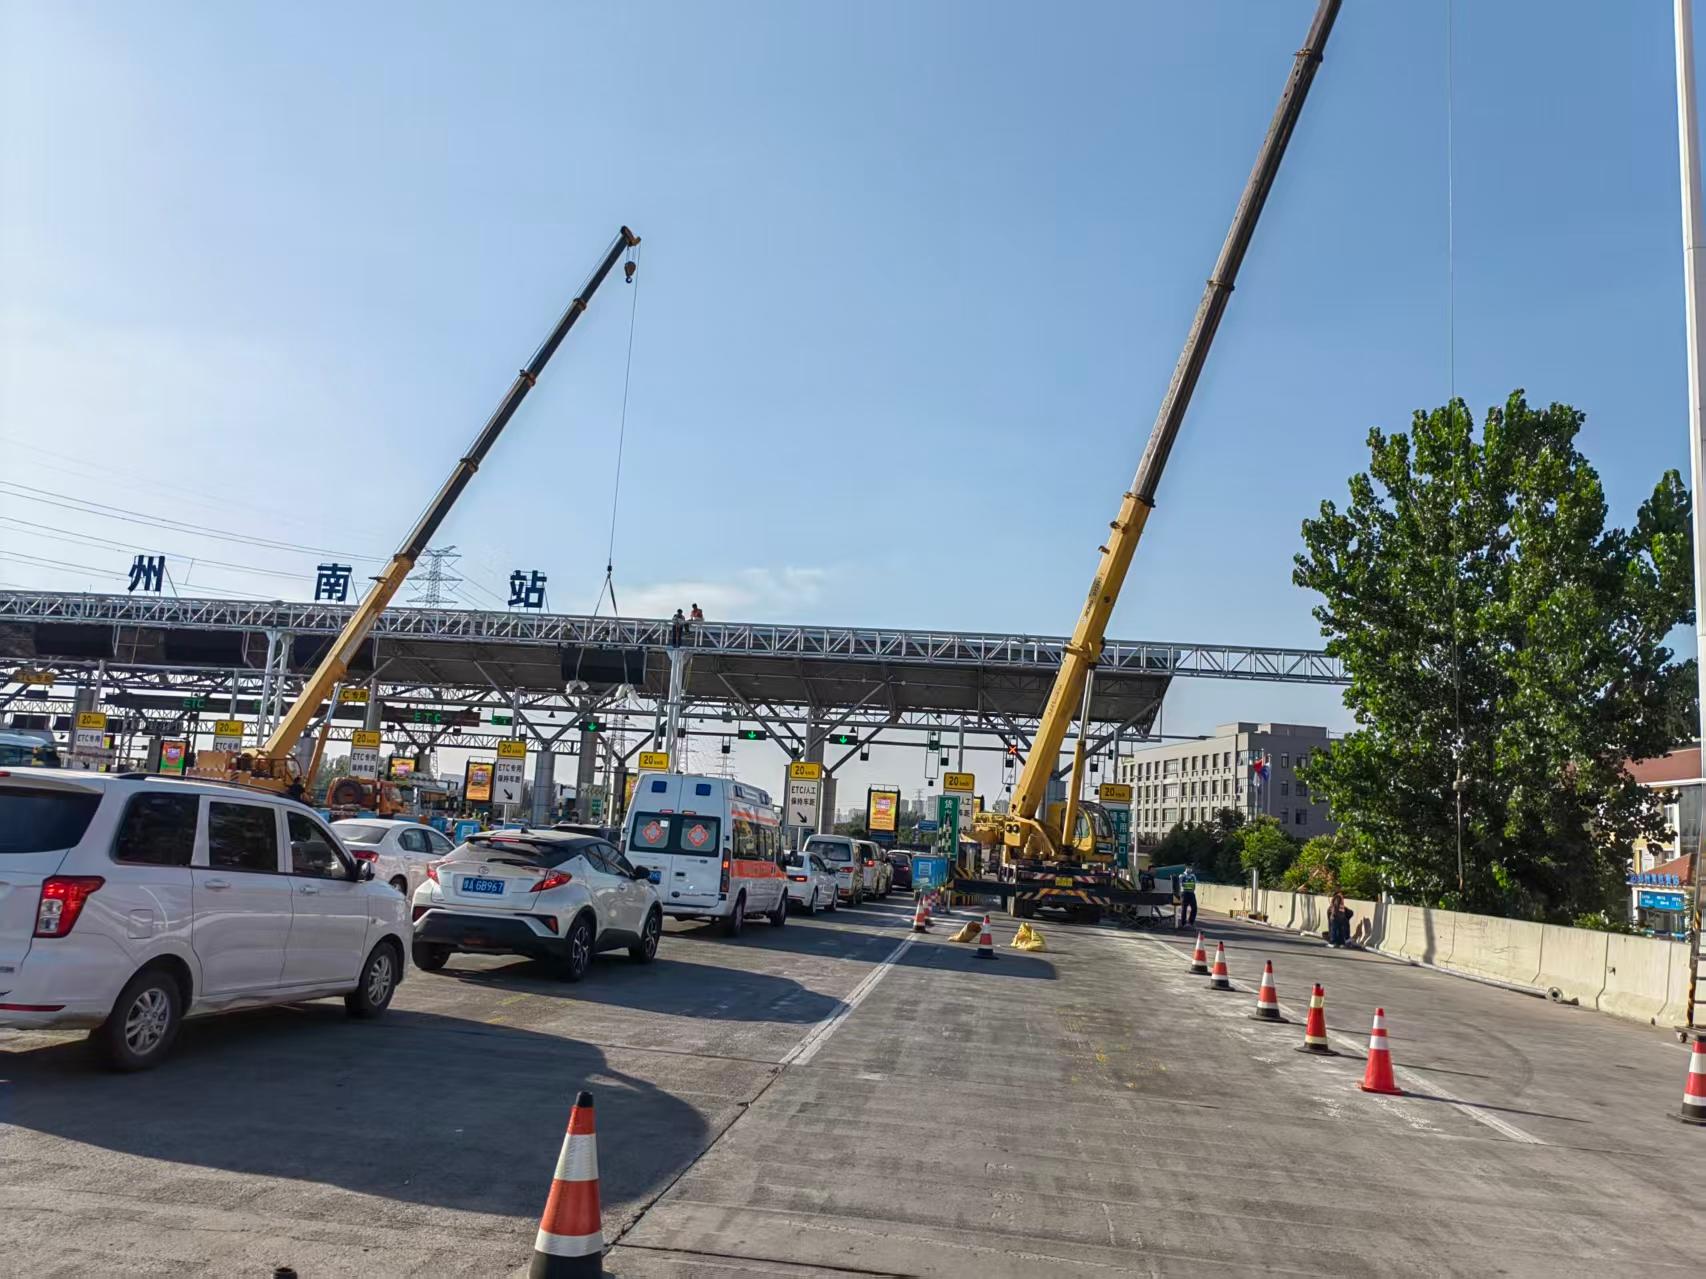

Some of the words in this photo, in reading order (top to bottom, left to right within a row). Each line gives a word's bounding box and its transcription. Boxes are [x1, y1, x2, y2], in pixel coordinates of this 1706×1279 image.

[128, 555, 165, 592] 州
[314, 563, 352, 602] 南
[508, 570, 547, 608] 站
[81, 714, 92, 725] 20
[414, 712, 442, 723] ETC
[219, 723, 230, 733] 20
[356, 733, 367, 743] 20
[502, 743, 512, 753] 20
[643, 755, 654, 765] 20
[794, 765, 805, 775] 20
[948, 776, 959, 786] 20
[791, 785, 817, 795] ETC/人工
[1104, 786, 1115, 797] 20
